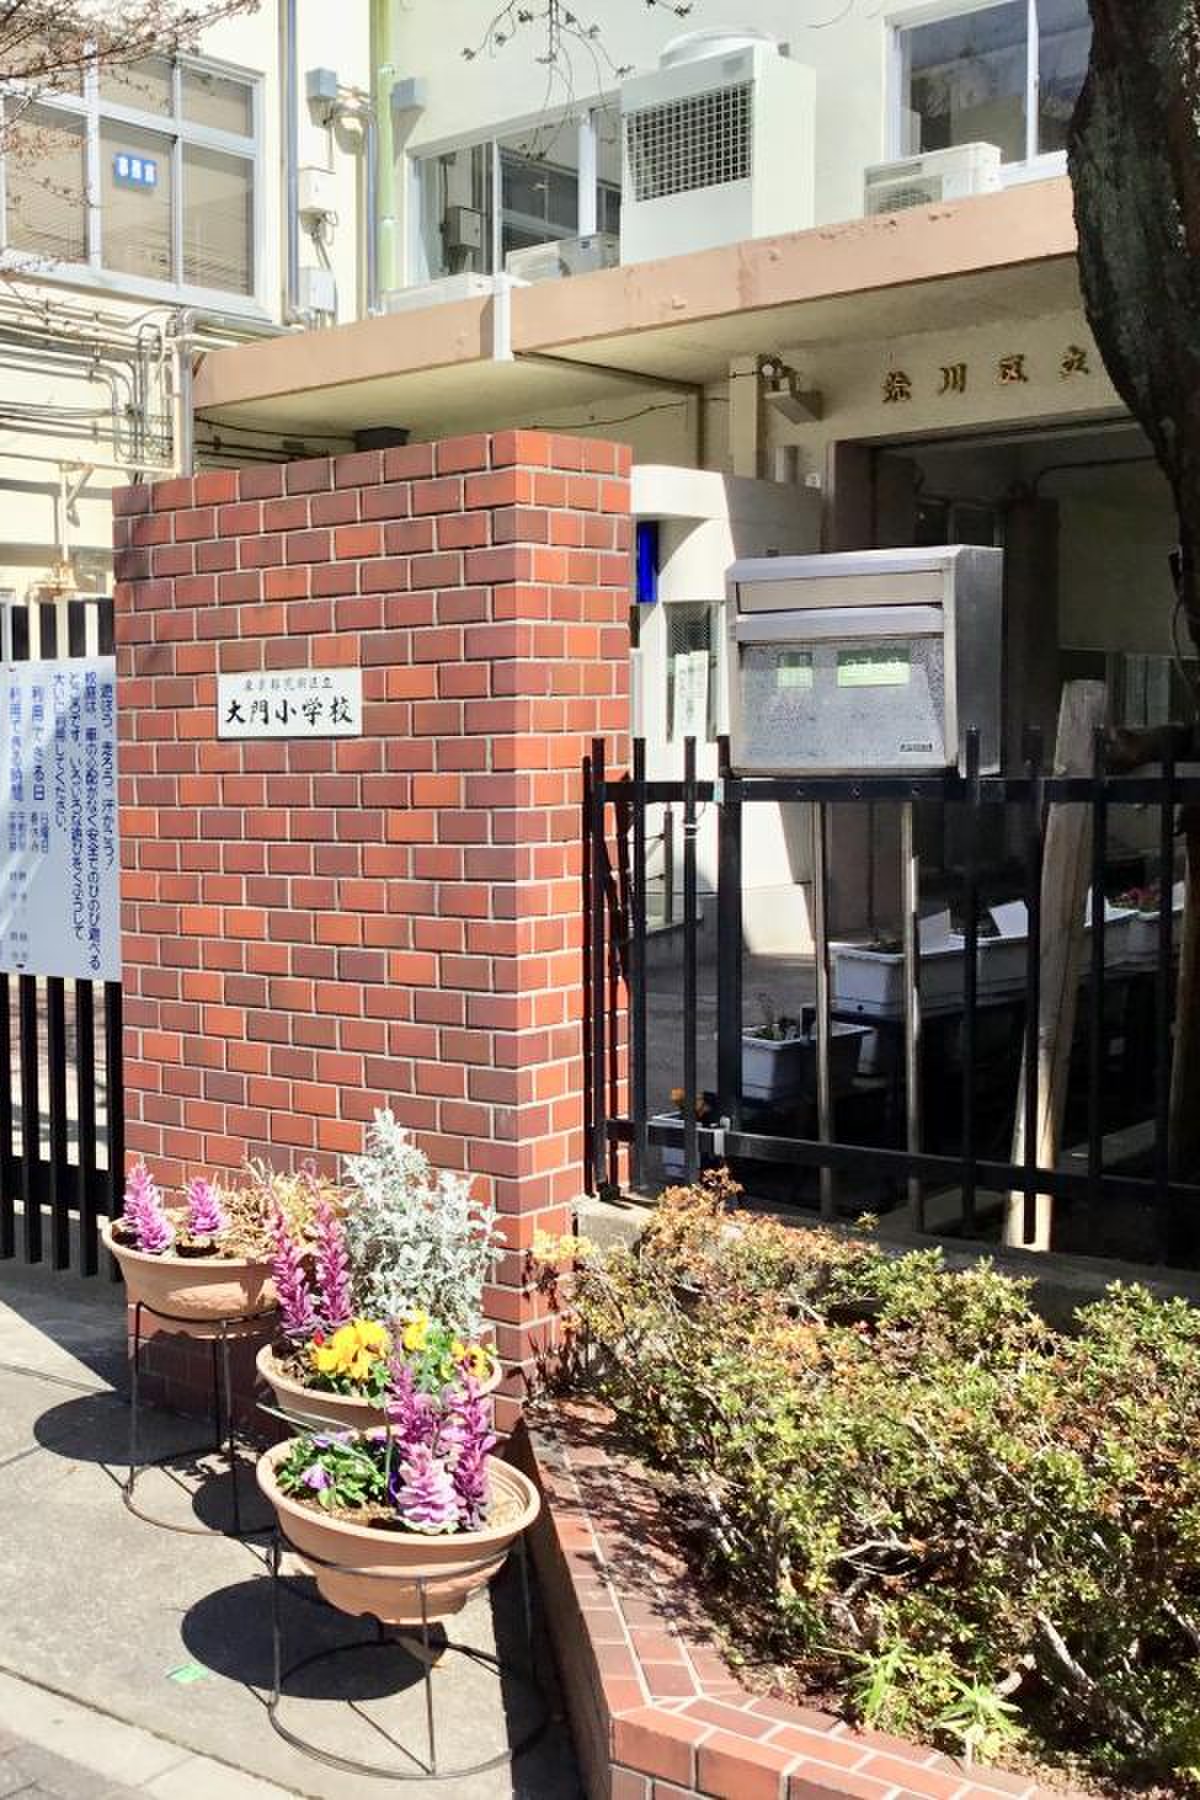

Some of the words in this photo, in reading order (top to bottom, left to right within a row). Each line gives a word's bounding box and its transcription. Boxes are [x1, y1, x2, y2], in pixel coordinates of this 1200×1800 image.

[225, 696, 353, 726] 大門小学校
